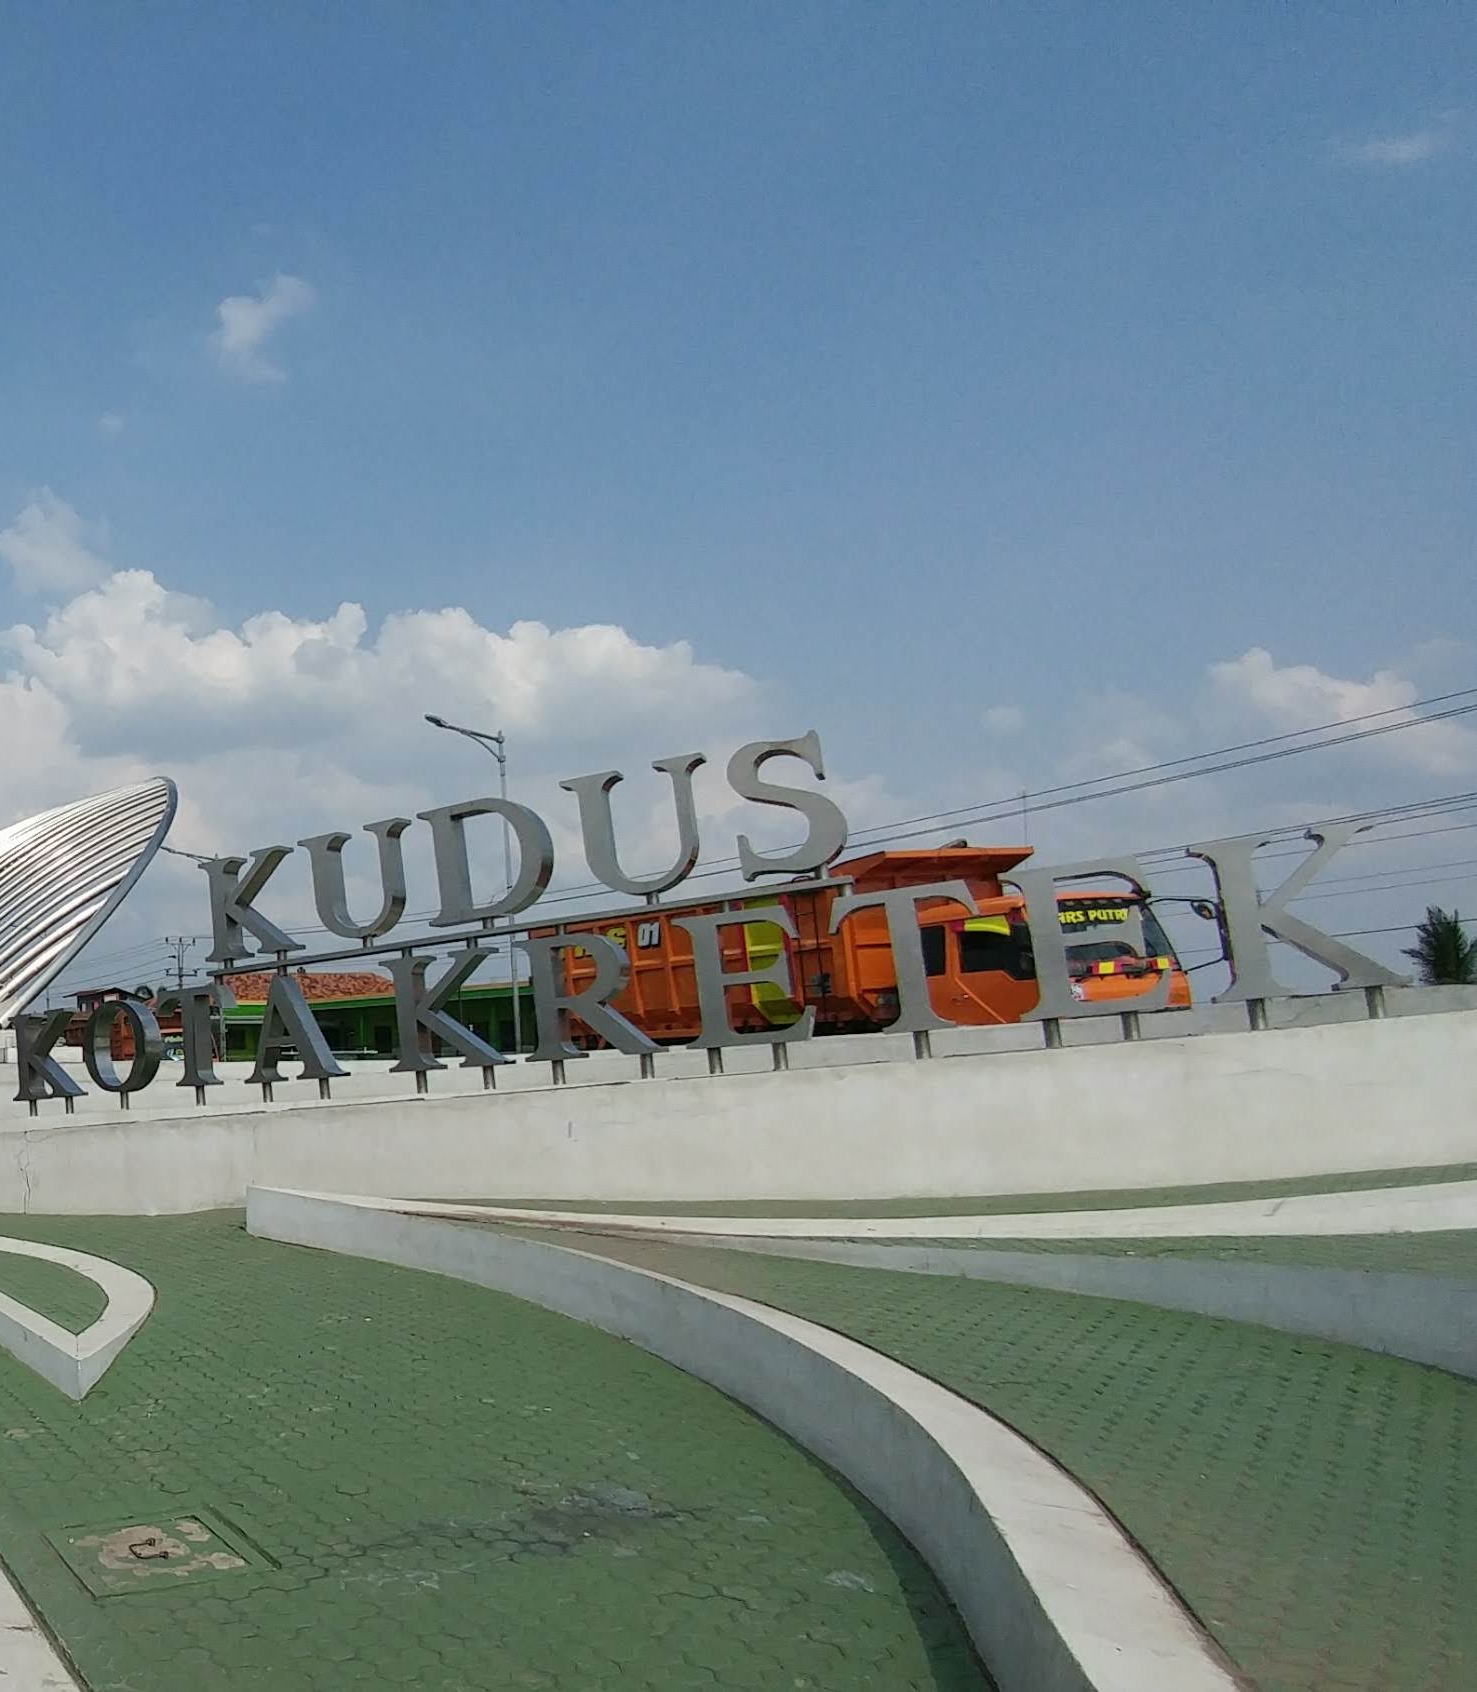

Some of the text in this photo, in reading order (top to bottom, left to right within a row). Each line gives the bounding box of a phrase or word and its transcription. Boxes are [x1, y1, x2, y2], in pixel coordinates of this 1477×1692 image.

[11, 824, 1412, 1101] KOTA KRETEK
[198, 729, 847, 963] KUDUS
[637, 922, 660, 948] 01
